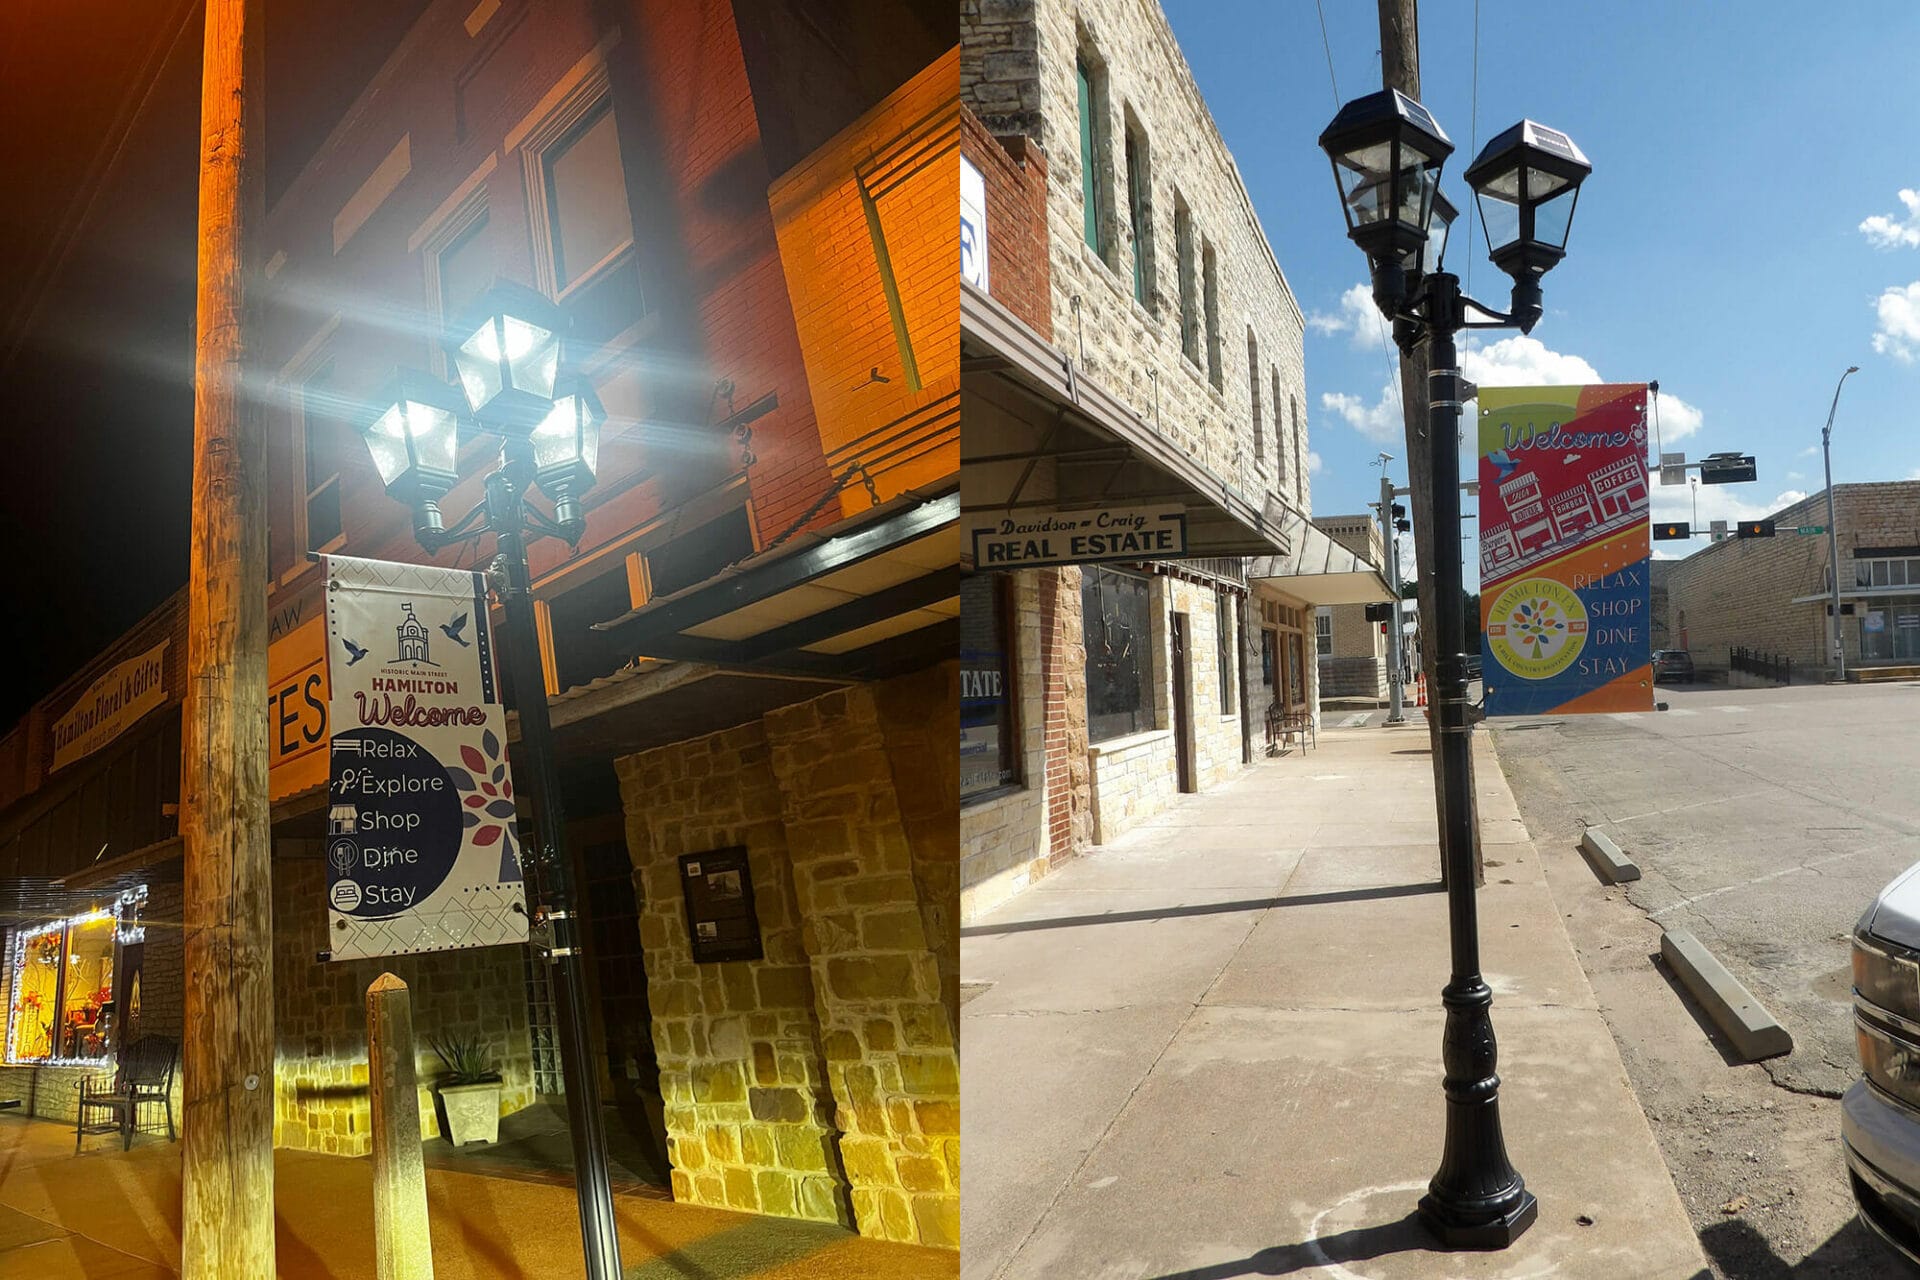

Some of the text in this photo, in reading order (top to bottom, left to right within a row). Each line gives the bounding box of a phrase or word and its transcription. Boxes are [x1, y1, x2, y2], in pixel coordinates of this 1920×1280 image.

[1501, 421, 1629, 451] Welcome
[1597, 466, 1638, 492] COFFEE
[1000, 517, 1076, 535] Davidson
[1097, 512, 1147, 530] Craig
[987, 530, 1173, 563] REAL ESTATE
[1573, 571, 1641, 590] RELAX
[1590, 598, 1641, 618] SHOP
[1596, 627, 1639, 646] DINE
[380, 668, 409, 676] HISTORIC
[1578, 657, 1630, 676] STAY
[372, 678, 458, 694] HAMILTON
[57, 710, 94, 750] Hamilton
[95, 680, 123, 725] Floral
[125, 677, 133, 705] &
[133, 659, 160, 698] Gifts
[354, 691, 487, 728] Welcome
[363, 739, 418, 759] Relax
[362, 774, 444, 797] Explore
[361, 810, 421, 832] Shop
[364, 847, 419, 868] Dine
[365, 884, 417, 907] Stay
